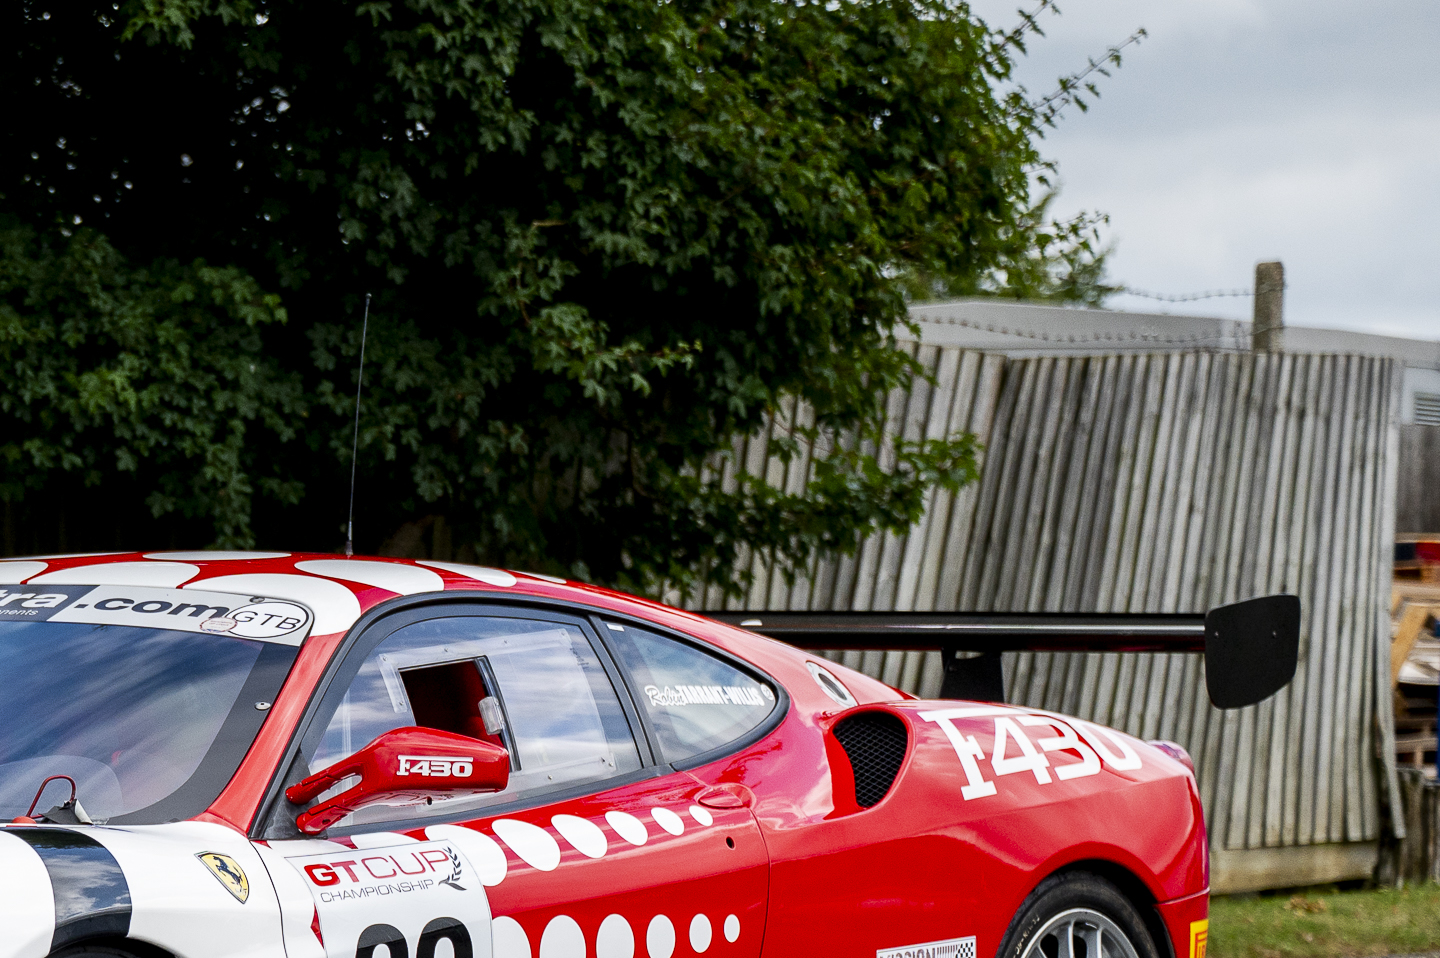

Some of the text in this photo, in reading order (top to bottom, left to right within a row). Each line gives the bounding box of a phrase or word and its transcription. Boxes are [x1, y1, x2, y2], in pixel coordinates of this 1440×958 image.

[232, 610, 301, 630] GTB
[396, 754, 474, 778] F430
[917, 707, 1143, 801] F430
[320, 879, 434, 903] CHAMPIONSHIP
